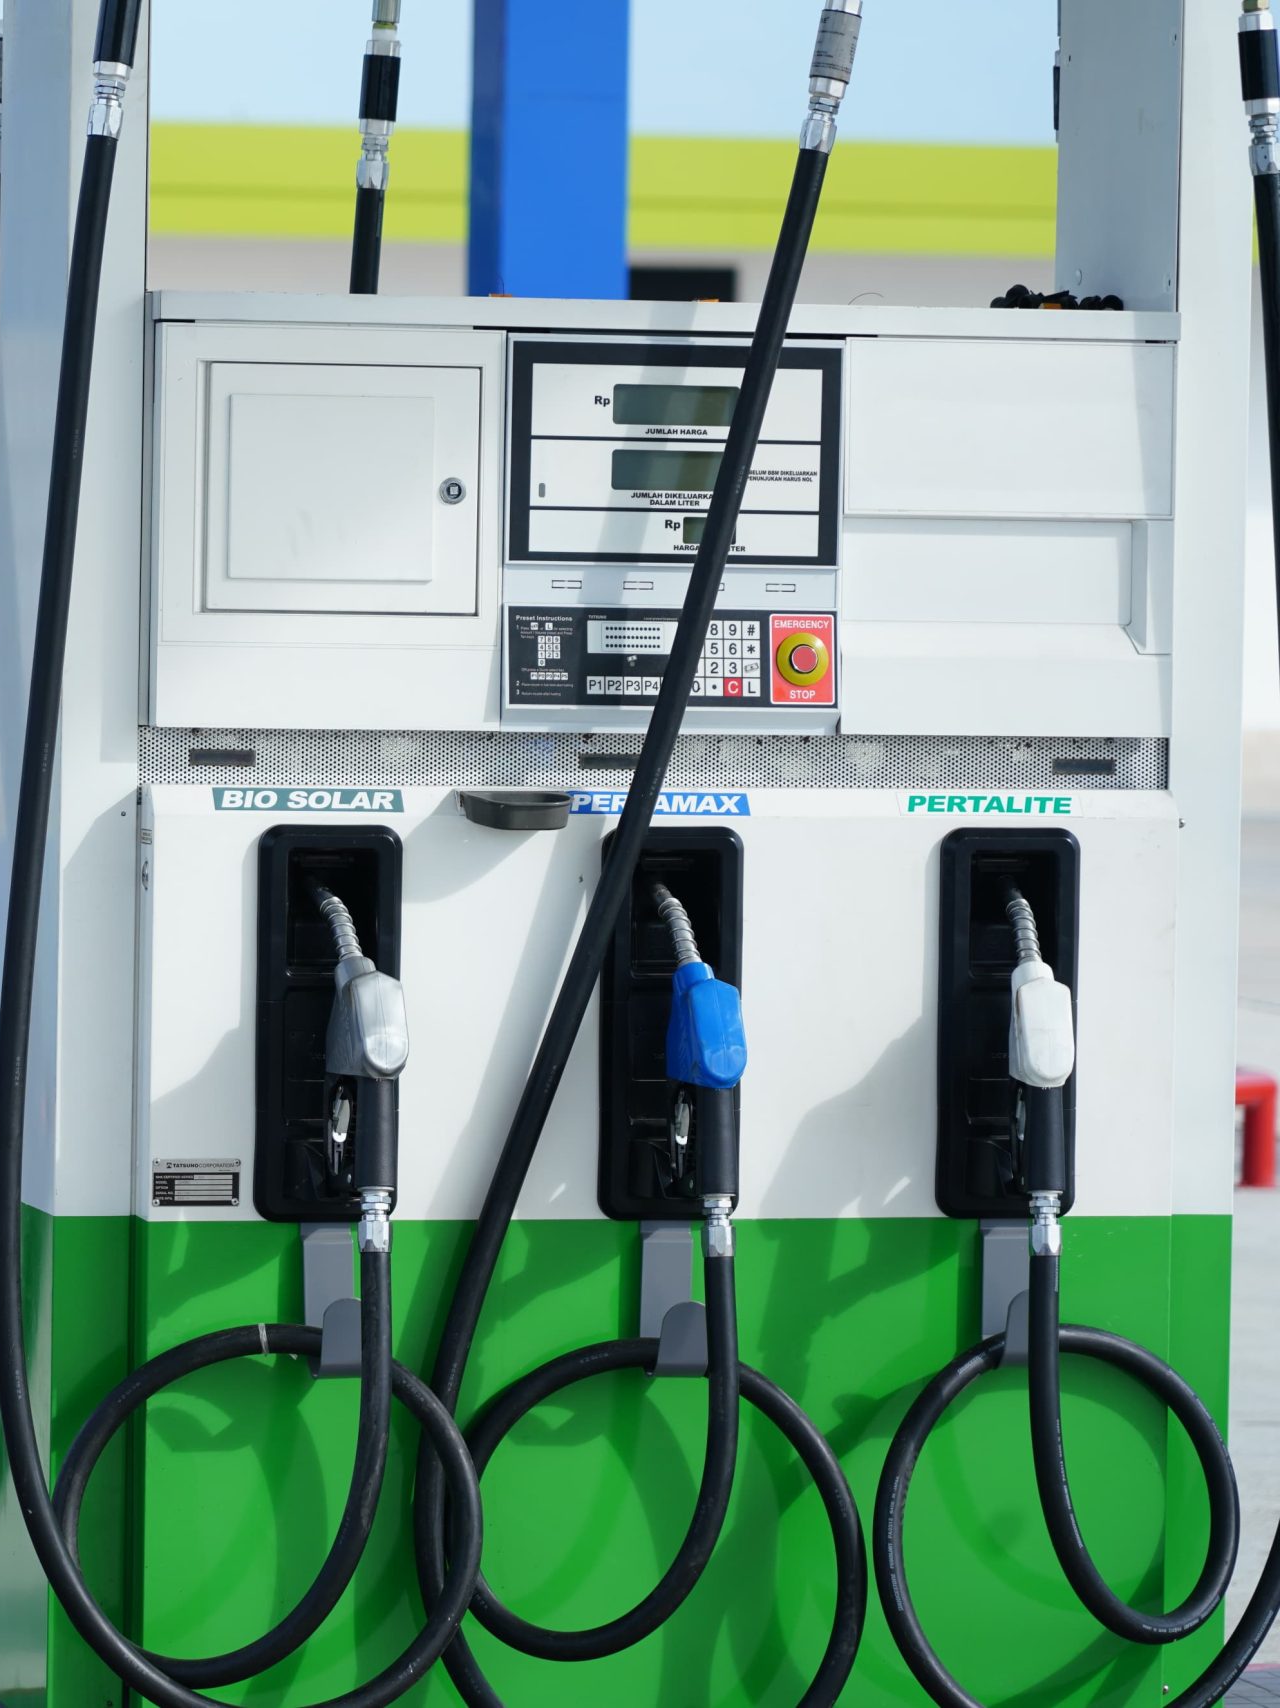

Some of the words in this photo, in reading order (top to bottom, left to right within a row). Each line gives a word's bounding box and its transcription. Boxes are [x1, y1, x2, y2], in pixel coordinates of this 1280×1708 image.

[594, 396, 610, 407] Rp
[664, 520, 680, 531] Rp
[710, 624, 718, 636] 8
[728, 624, 737, 636] 9
[747, 624, 756, 636] #
[774, 620, 829, 629] EMERGENCY
[710, 643, 718, 654] 5
[728, 643, 737, 655] 6
[710, 662, 718, 674] 2
[728, 662, 737, 674] 3
[588, 680, 602, 690] P1
[607, 680, 622, 691] P2
[626, 681, 640, 692] P3
[644, 682, 658, 692] P4
[728, 680, 738, 693] C
[748, 682, 756, 693] L
[790, 690, 816, 699] STOP
[221, 790, 276, 808] BIO
[287, 791, 394, 810] SOLAR
[570, 794, 740, 814] PERAMAX
[907, 795, 1072, 814] PERTALITE
